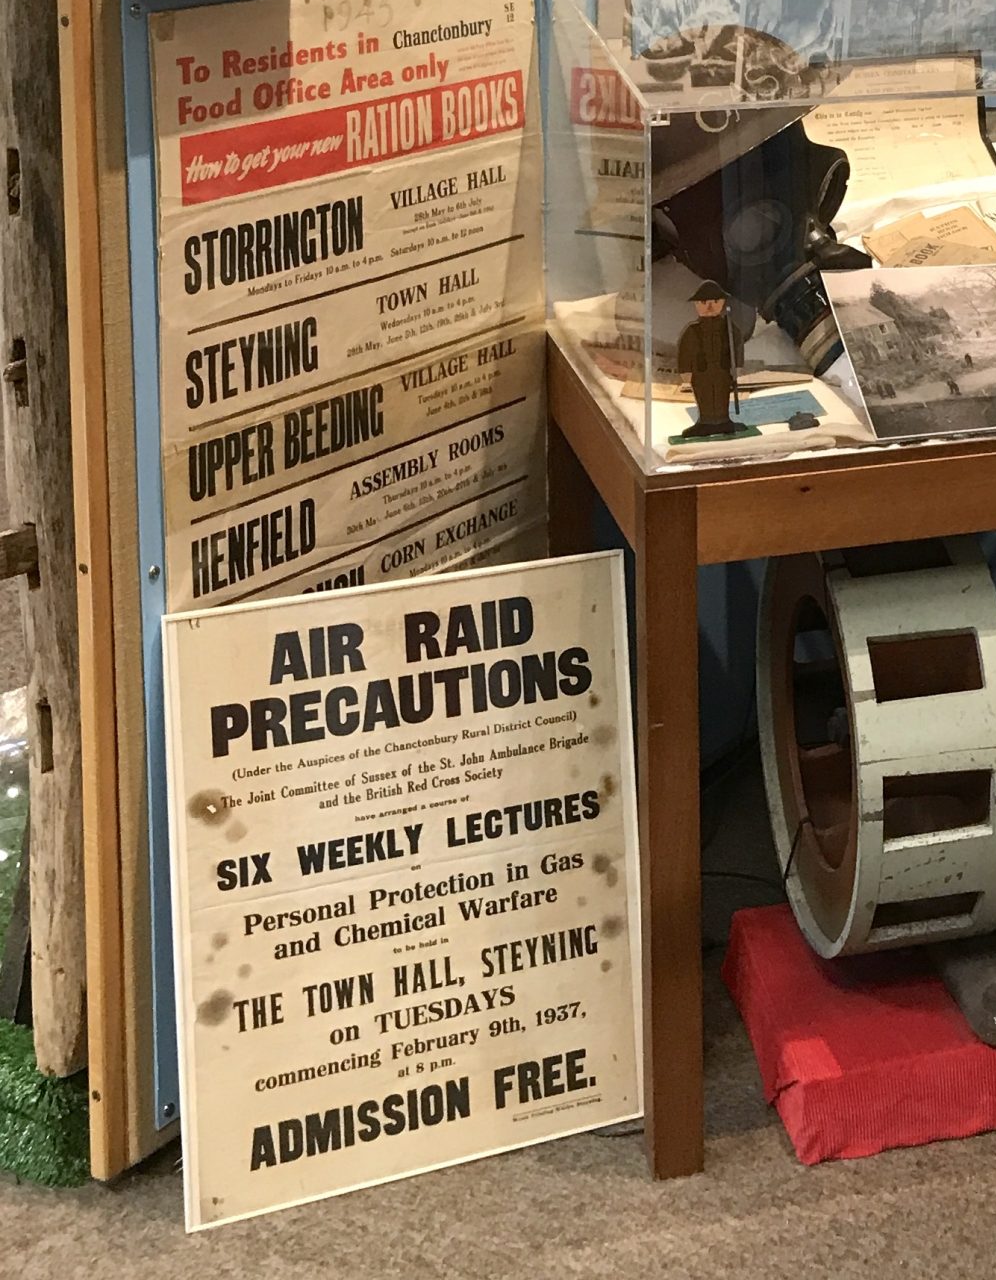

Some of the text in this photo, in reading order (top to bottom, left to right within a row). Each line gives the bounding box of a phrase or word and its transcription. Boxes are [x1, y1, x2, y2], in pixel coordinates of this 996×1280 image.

[177, 18, 492, 85] To Residents in Chanctonbury
[178, 88, 241, 125] Food
[253, 78, 330, 110] Office
[341, 67, 394, 95] Area
[402, 52, 449, 84] only
[186, 77, 519, 184] How to get your new RATION BOOKS
[390, 165, 506, 210] VILLAGE HALL
[184, 196, 364, 295] STORRINGTON
[376, 267, 480, 315] TOWN HALL
[186, 317, 318, 409] STEYNING
[400, 339, 516, 392] VILLAGE HALL
[188, 384, 384, 502] UPPER BEEDING
[349, 425, 505, 500] ASSEMBLY ROOMS
[192, 498, 316, 598] HENFIELD
[381, 498, 518, 573] CORN EXCHANGE
[270, 596, 533, 686] AIR RAID
[211, 646, 593, 758] PRECAUTIONS
[232, 711, 577, 782] (Under the Auspices of the Chanctonbury Rural District Council)
[216, 790, 600, 891] SIX WEEKLY LECTURES
[244, 851, 584, 936] Personal Protection in Gas
[274, 888, 558, 960] and Chemical Warfare
[233, 925, 598, 1033] THE TOWN HALL, STEYNING
[420, 940, 438, 949] held
[255, 1001, 586, 1092] commencing February 9th, 1937,
[330, 986, 516, 1045] on TUESDAYS
[398, 1060, 456, 1078] at 8 p.m.
[250, 1048, 596, 1171] ADMISSION FREE.
